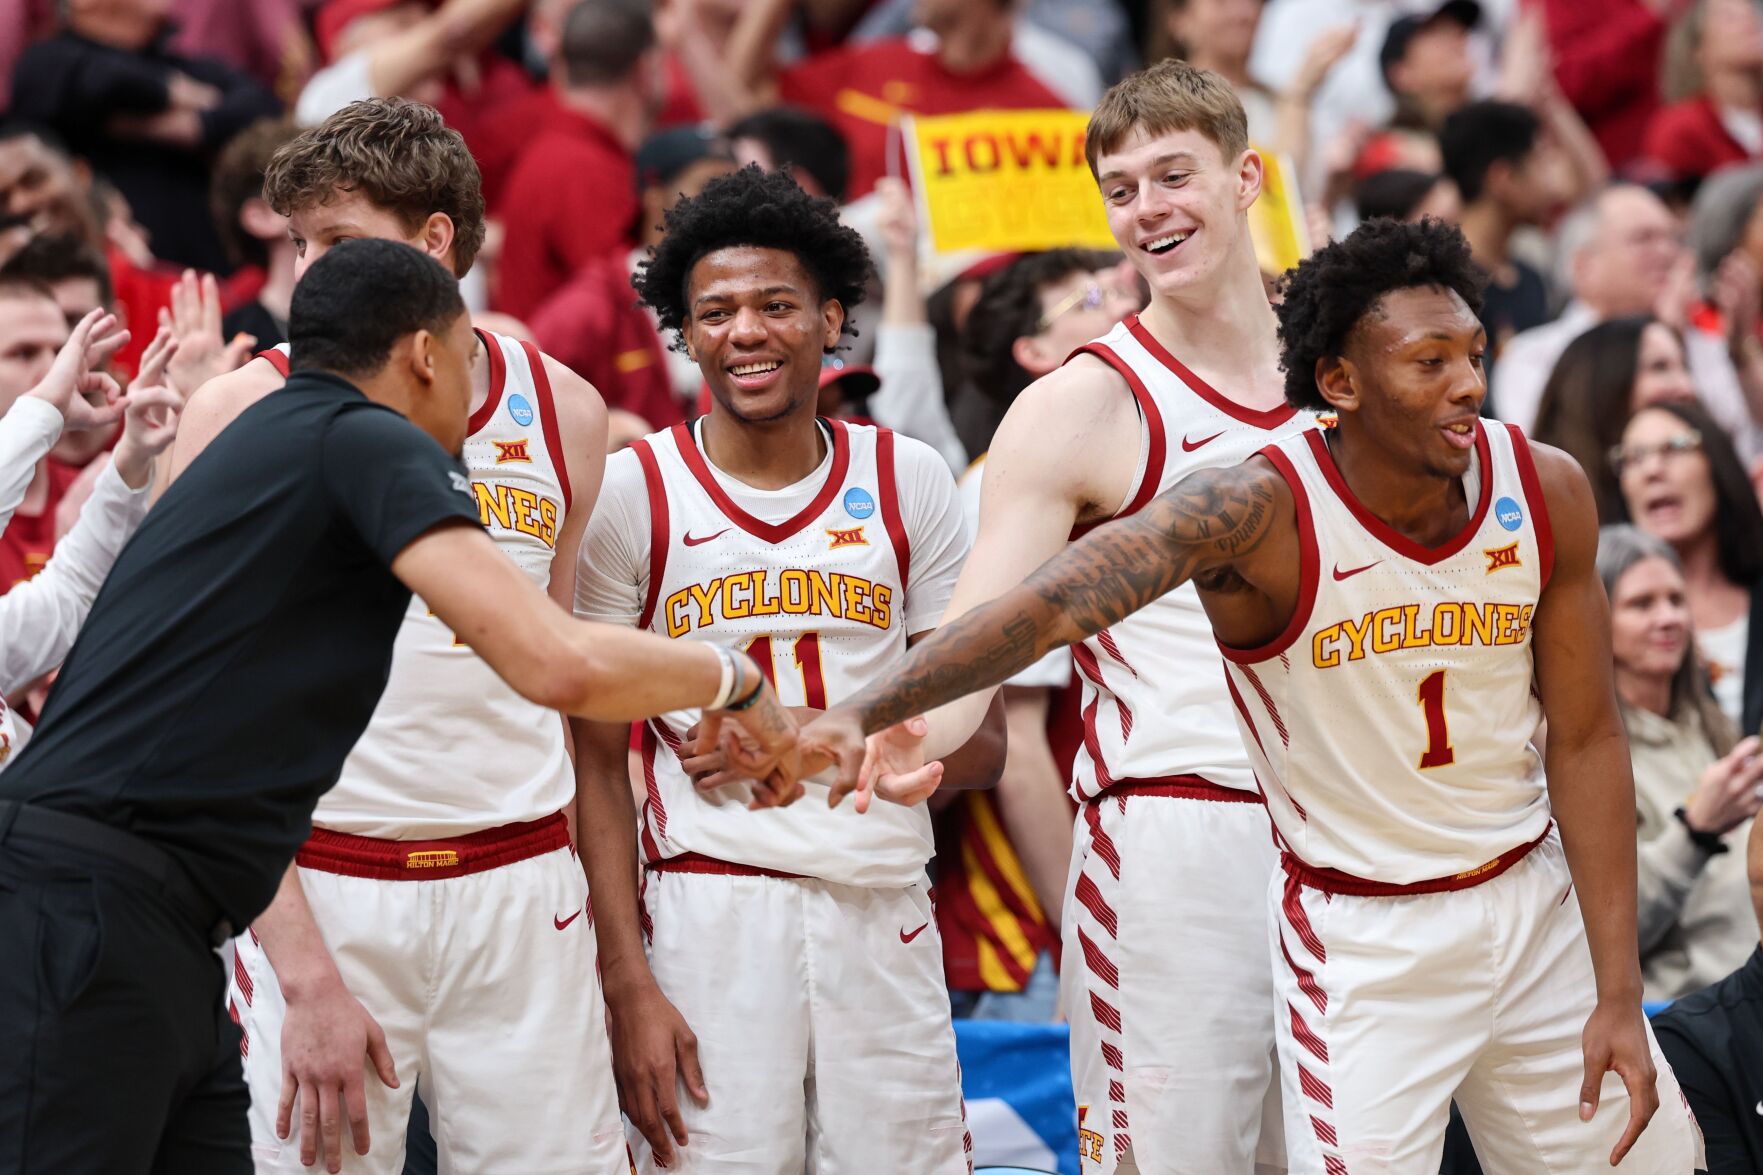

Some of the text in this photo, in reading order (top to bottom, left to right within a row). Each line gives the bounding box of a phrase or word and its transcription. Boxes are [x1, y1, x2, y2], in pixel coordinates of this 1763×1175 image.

[848, 501, 873, 511] NCAA
[1500, 511, 1522, 523] NCAA
[665, 569, 893, 639] CYCLONES
[1312, 602, 1534, 669] CYCLONES
[1417, 668, 1456, 770] 1
[406, 860, 435, 868] HILTON
